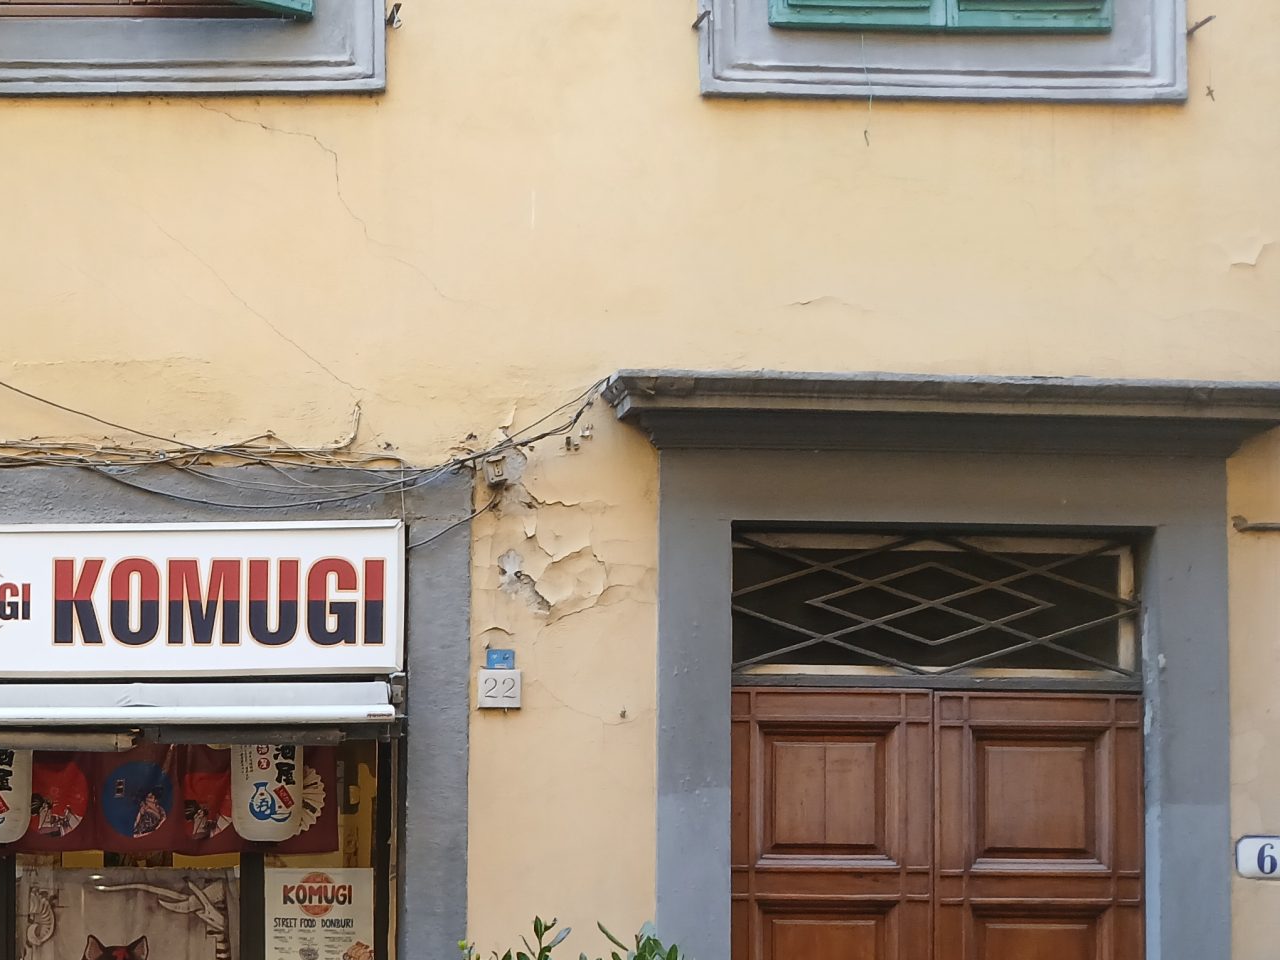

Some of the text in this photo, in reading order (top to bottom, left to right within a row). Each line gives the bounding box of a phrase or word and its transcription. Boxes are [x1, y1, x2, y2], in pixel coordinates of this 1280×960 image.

[53, 556, 387, 646] KOMUGI
[484, 677, 517, 699] 22
[1256, 843, 1278, 875] 6
[283, 884, 353, 905] KOMUGI
[273, 917, 317, 928] STREET FOOD
[321, 918, 354, 929] DONBURI
